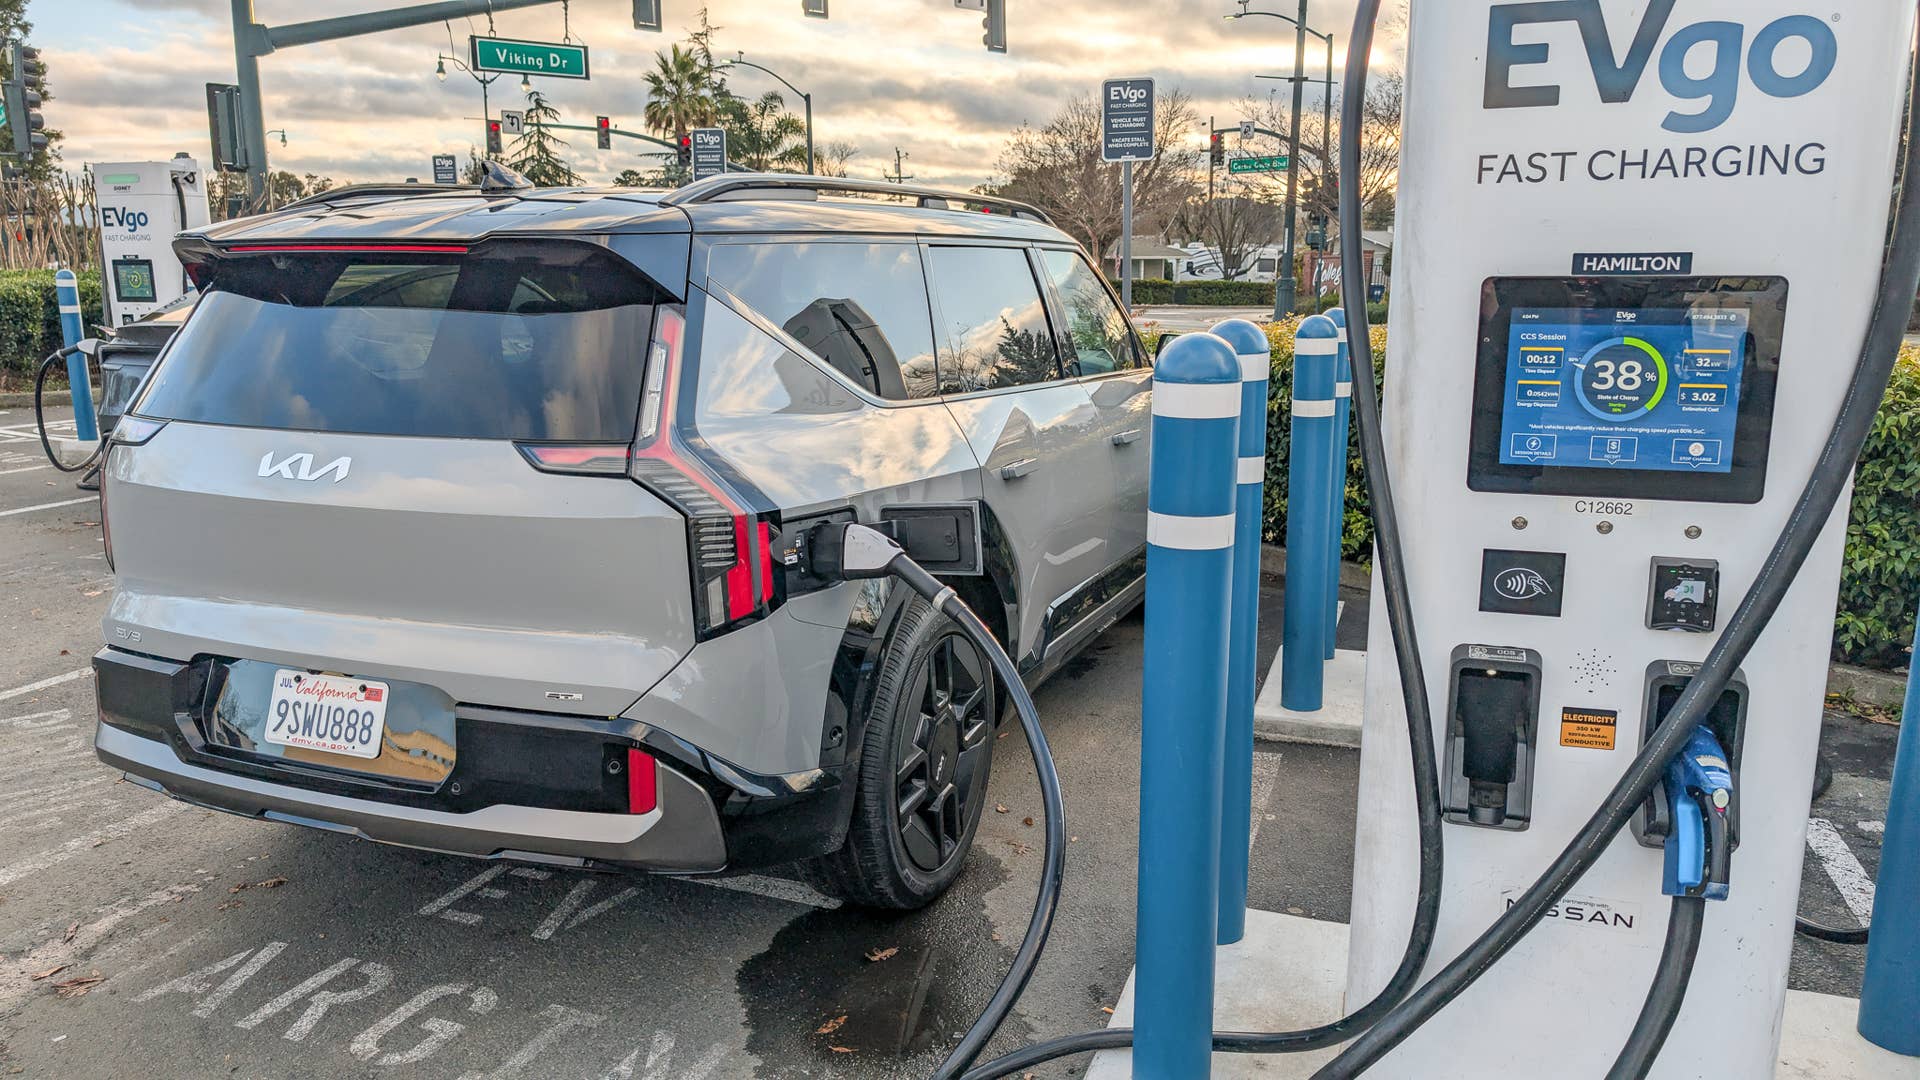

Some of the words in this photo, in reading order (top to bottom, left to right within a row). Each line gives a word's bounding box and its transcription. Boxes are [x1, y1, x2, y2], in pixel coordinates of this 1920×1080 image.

[496, 48, 543, 69] Viking
[549, 53, 568, 68] Dr
[1482, 0, 1838, 133] EVgo
[1110, 86, 1146, 102] EVgo
[696, 134, 720, 145] EVgo
[1476, 152, 1578, 184] FAST
[1586, 142, 1826, 180] CHARGING
[102, 207, 148, 232] EVgo
[1583, 256, 1680, 271] HAMILTON
[1616, 312, 1636, 320] EVgo
[1527, 355, 1556, 363] 00:12
[1692, 392, 1716, 401] 3.02
[258, 450, 352, 484] KIA
[1575, 500, 1632, 515] C12662
[280, 678, 293, 688] JUL
[296, 678, 364, 702] California
[272, 699, 374, 745] 9SWU888
[1563, 713, 1615, 723] ELECTRICITY
[292, 737, 349, 750] dmv.ca.gov
[1564, 738, 1610, 746] CONDUCTIVE
[418, 863, 643, 940] EV
